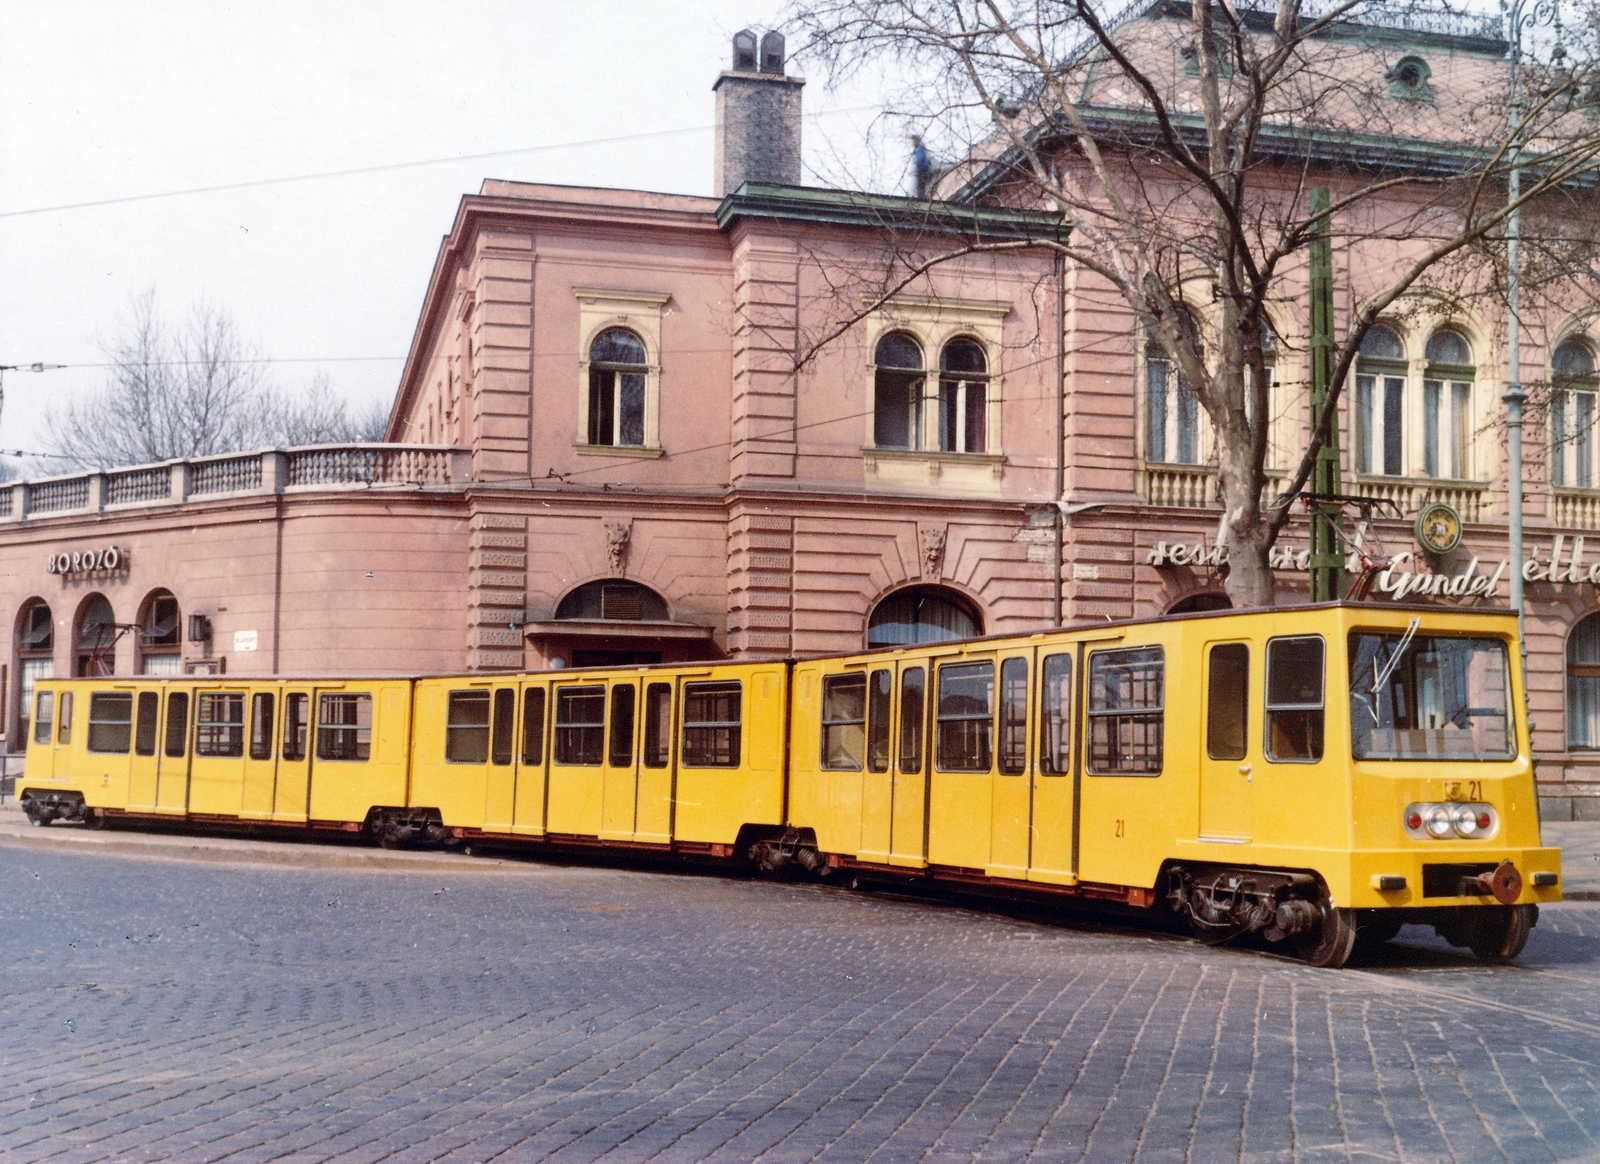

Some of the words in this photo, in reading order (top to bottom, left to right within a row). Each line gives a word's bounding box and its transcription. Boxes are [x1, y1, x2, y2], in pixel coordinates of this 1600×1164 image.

[48, 545, 118, 573] BOROZÓ
[1380, 551, 1507, 600] Gundel
[1468, 780, 1483, 801] 21
[1115, 819, 1125, 838] 21
